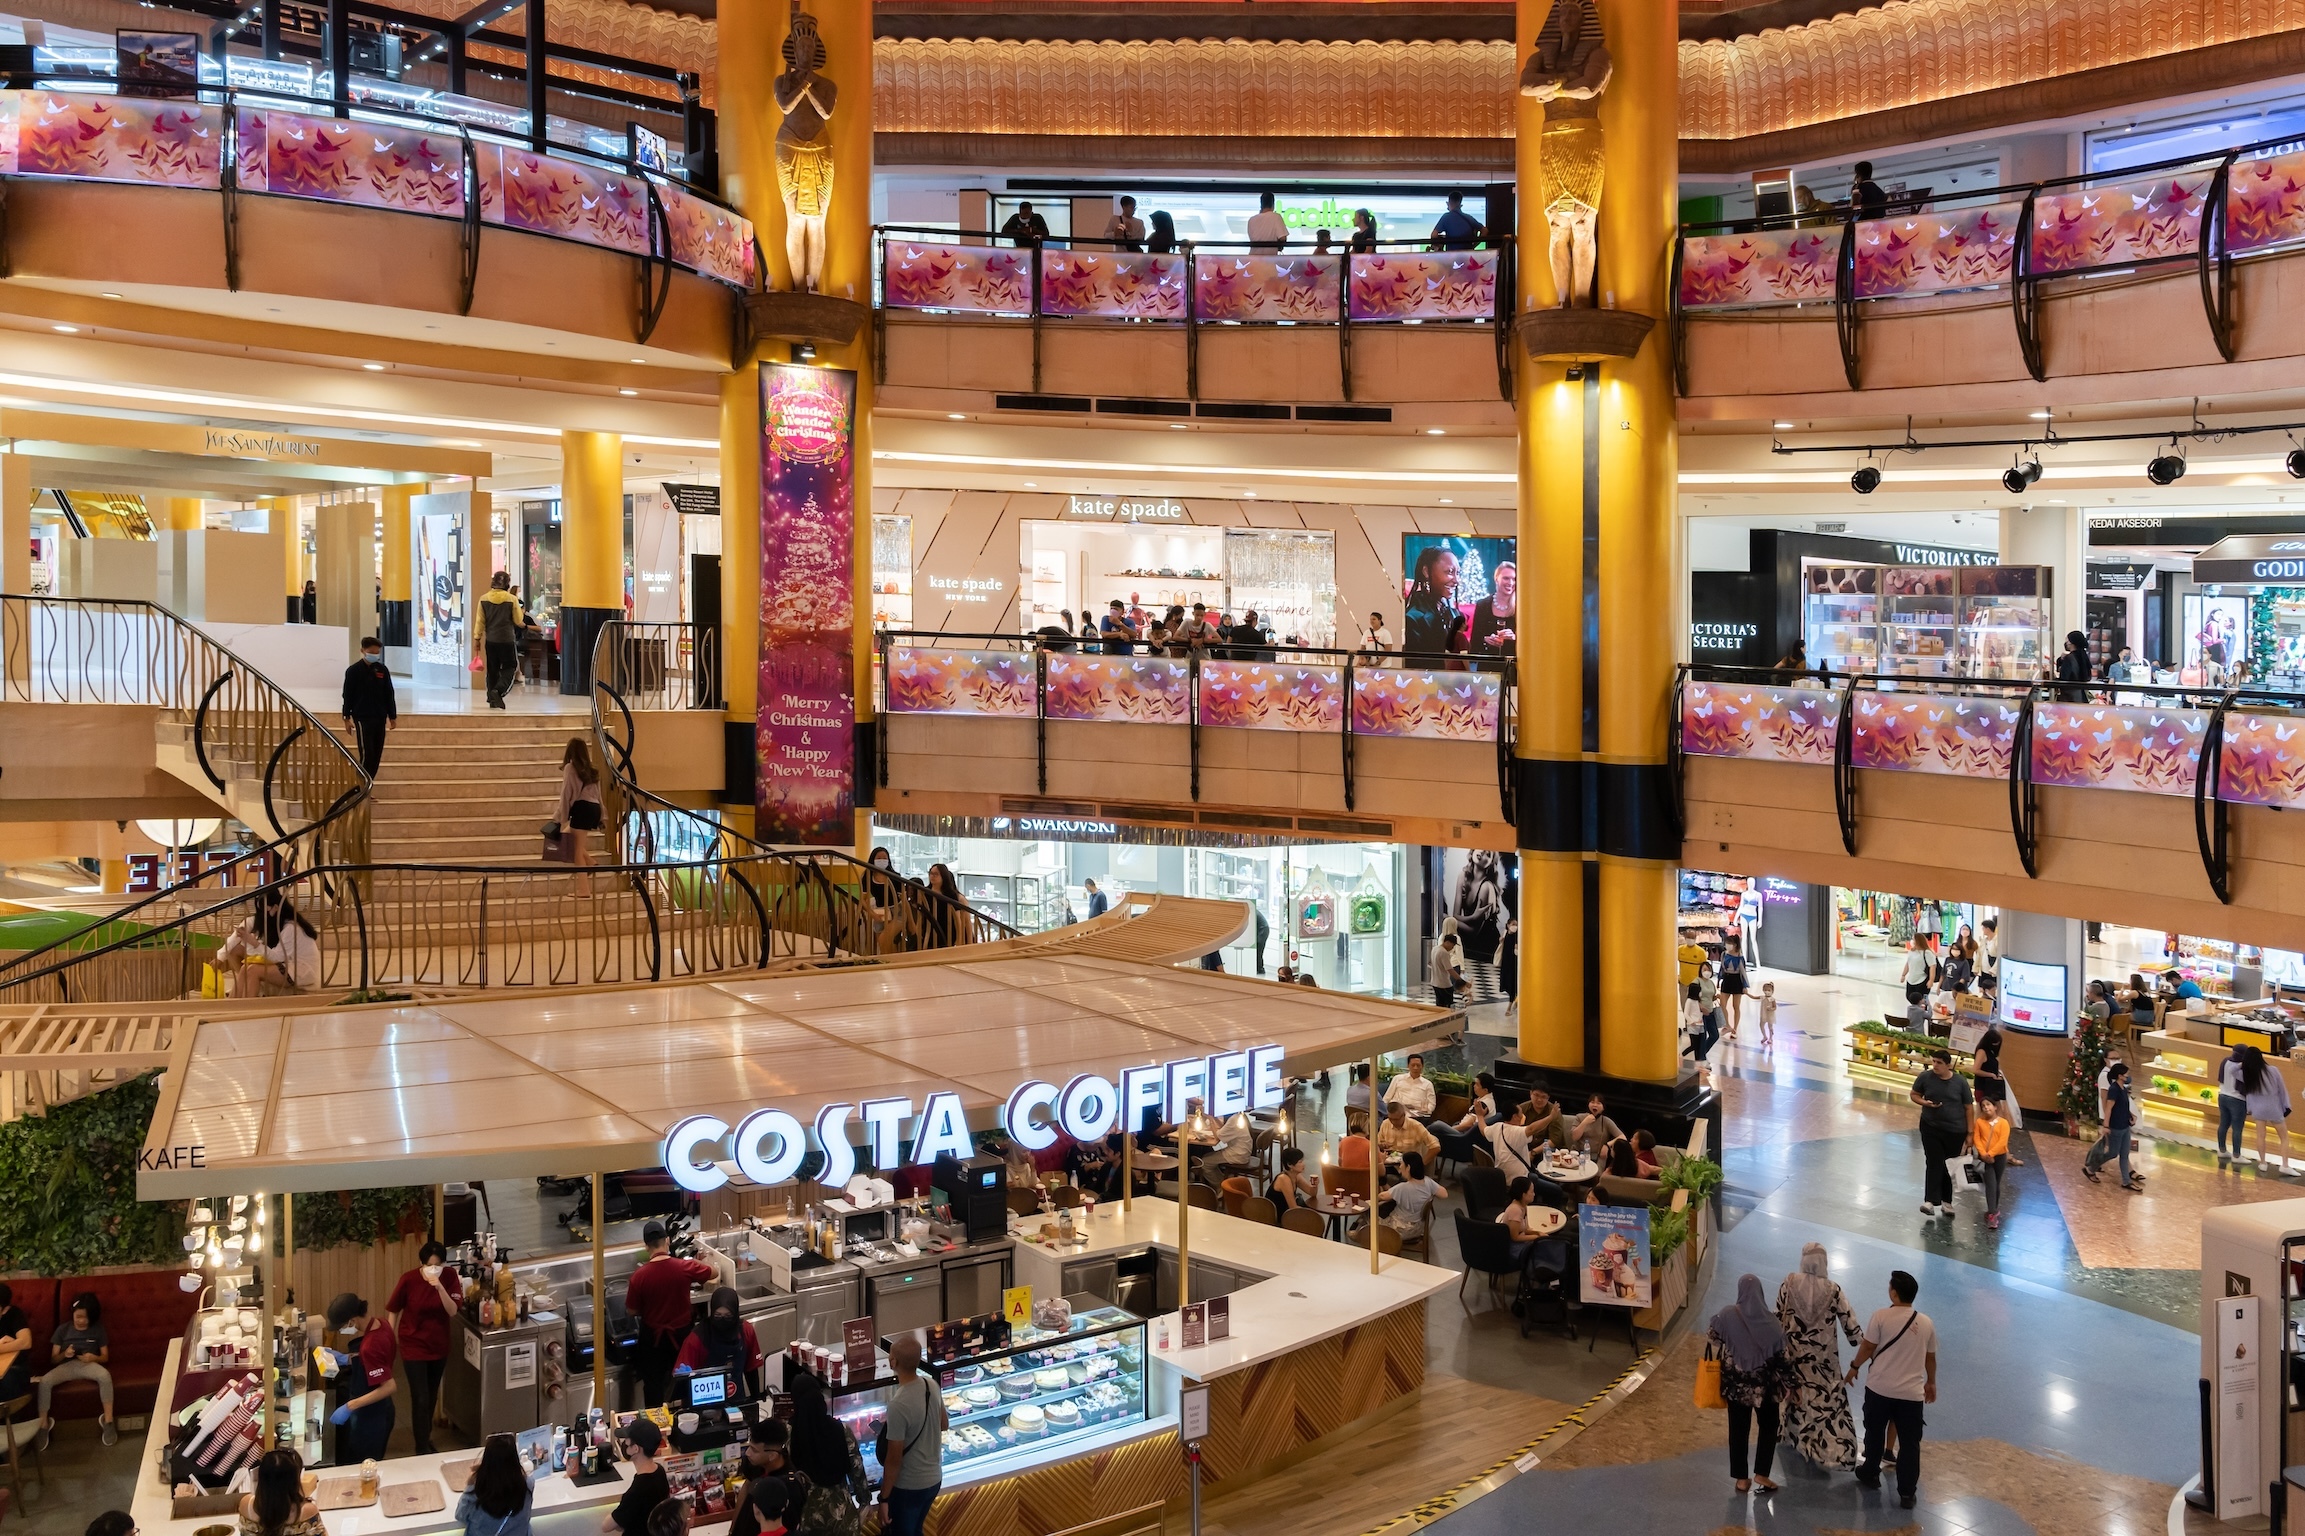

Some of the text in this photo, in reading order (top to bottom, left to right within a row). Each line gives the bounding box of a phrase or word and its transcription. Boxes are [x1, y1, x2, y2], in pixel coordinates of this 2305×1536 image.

[782, 404, 831, 419] Wander
[781, 415, 831, 429] Wonder
[777, 426, 836, 443] Christmas
[1070, 496, 1181, 521] kate spade
[2089, 518, 2162, 529] KEDAI AKSESORI
[1896, 545, 1969, 566] VICTORIA'S
[929, 575, 1003, 593] kate spade
[945, 593, 986, 602] NEW YORK
[1691, 623, 1757, 636] ICTORIA'S
[1693, 635, 1743, 649] SECRET
[781, 694, 832, 712] Merry
[770, 712, 842, 728] Christmas
[801, 731, 811, 745] &
[781, 745, 831, 762] Happy
[769, 763, 843, 778] New Year
[1021, 818, 1115, 833] SWAROVSKI
[1963, 1003, 1984, 1011] HIRING
[664, 1043, 1285, 1192] COSTA COFFEE
[137, 1146, 206, 1171] KAFE
[1012, 1302, 1024, 1317] A
[693, 1381, 721, 1394] COSTA
